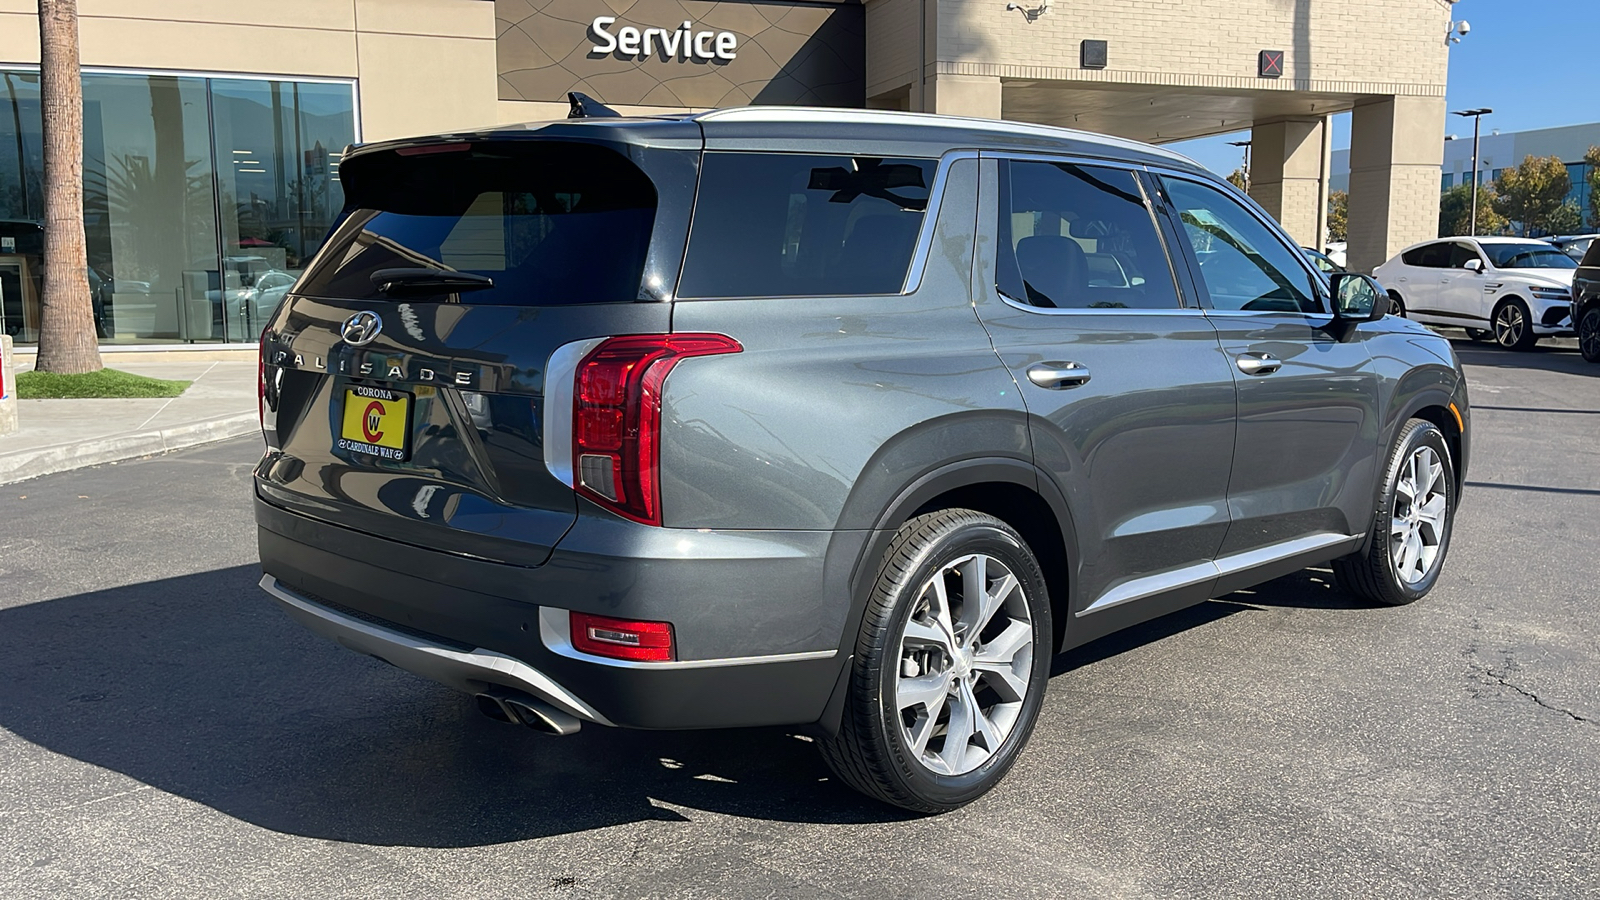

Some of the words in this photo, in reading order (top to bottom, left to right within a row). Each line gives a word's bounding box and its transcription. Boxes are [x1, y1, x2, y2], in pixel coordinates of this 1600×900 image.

[592, 15, 737, 60] Service
[277, 351, 473, 384] PALISADE
[357, 386, 393, 400] CORONA
[362, 401, 386, 443] C
[368, 415, 380, 431] W
[346, 441, 380, 456] CARDINALE
[380, 446, 395, 459] WAY
